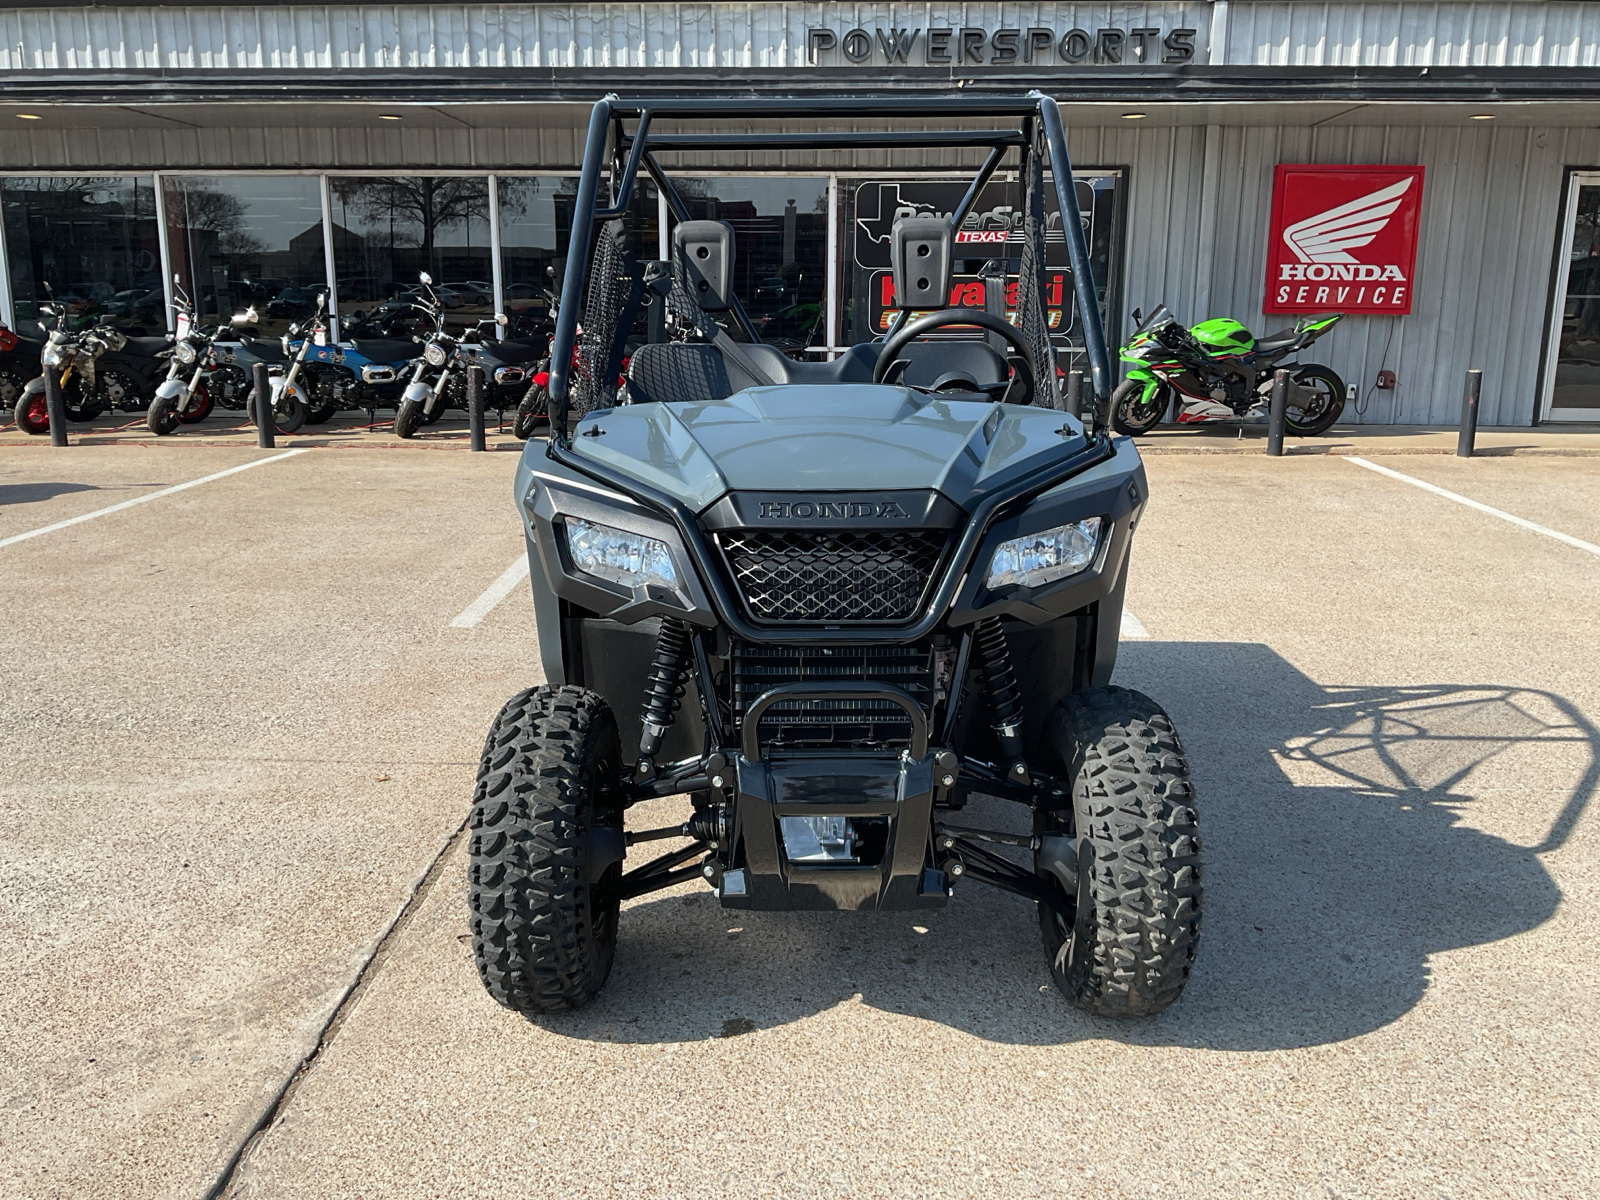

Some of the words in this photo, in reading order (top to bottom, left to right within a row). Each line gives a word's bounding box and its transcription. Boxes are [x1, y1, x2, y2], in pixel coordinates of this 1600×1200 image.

[807, 27, 1198, 64] POWERSPORTS
[963, 232, 1005, 242] TEXAS
[1279, 264, 1406, 281] HONDA
[1277, 285, 1405, 304] SERVICE
[758, 501, 910, 519] HONDA
